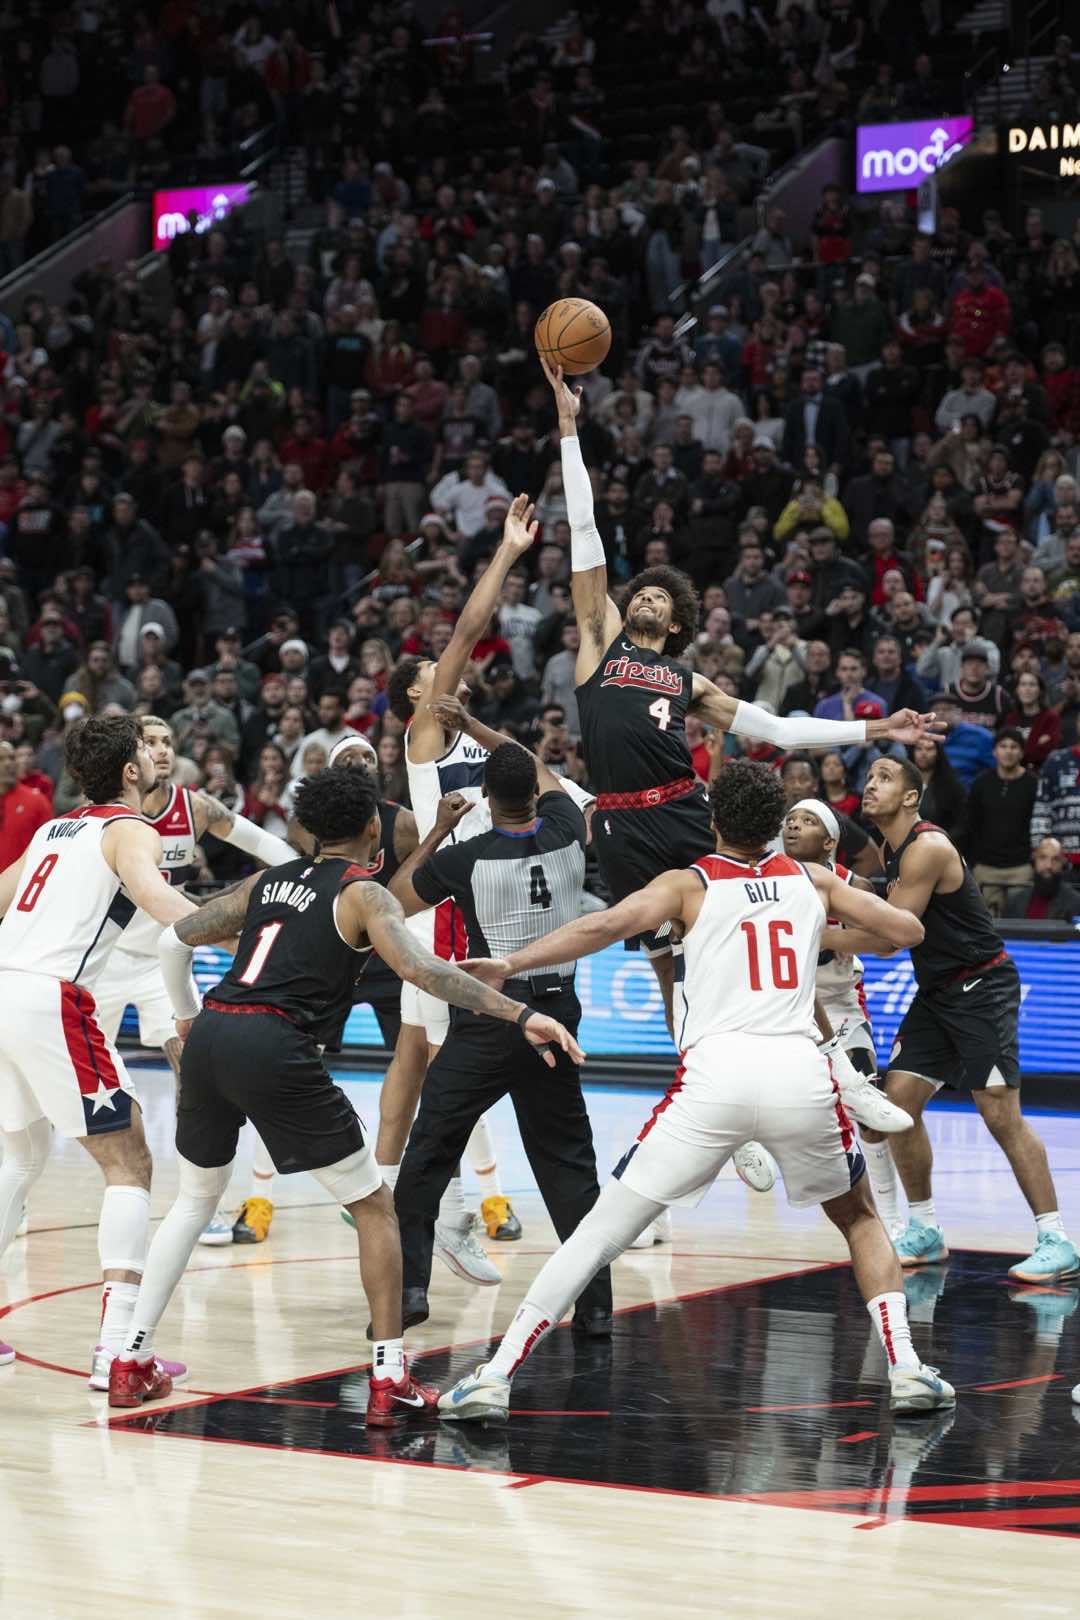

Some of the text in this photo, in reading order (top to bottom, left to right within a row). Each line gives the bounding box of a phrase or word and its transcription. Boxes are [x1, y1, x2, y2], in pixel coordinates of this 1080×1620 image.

[649, 697, 671, 731] 4
[16, 853, 59, 912] 8
[529, 865, 553, 909] 4
[744, 881, 781, 904] GILL
[239, 921, 283, 986] 1
[741, 920, 799, 991] 16
